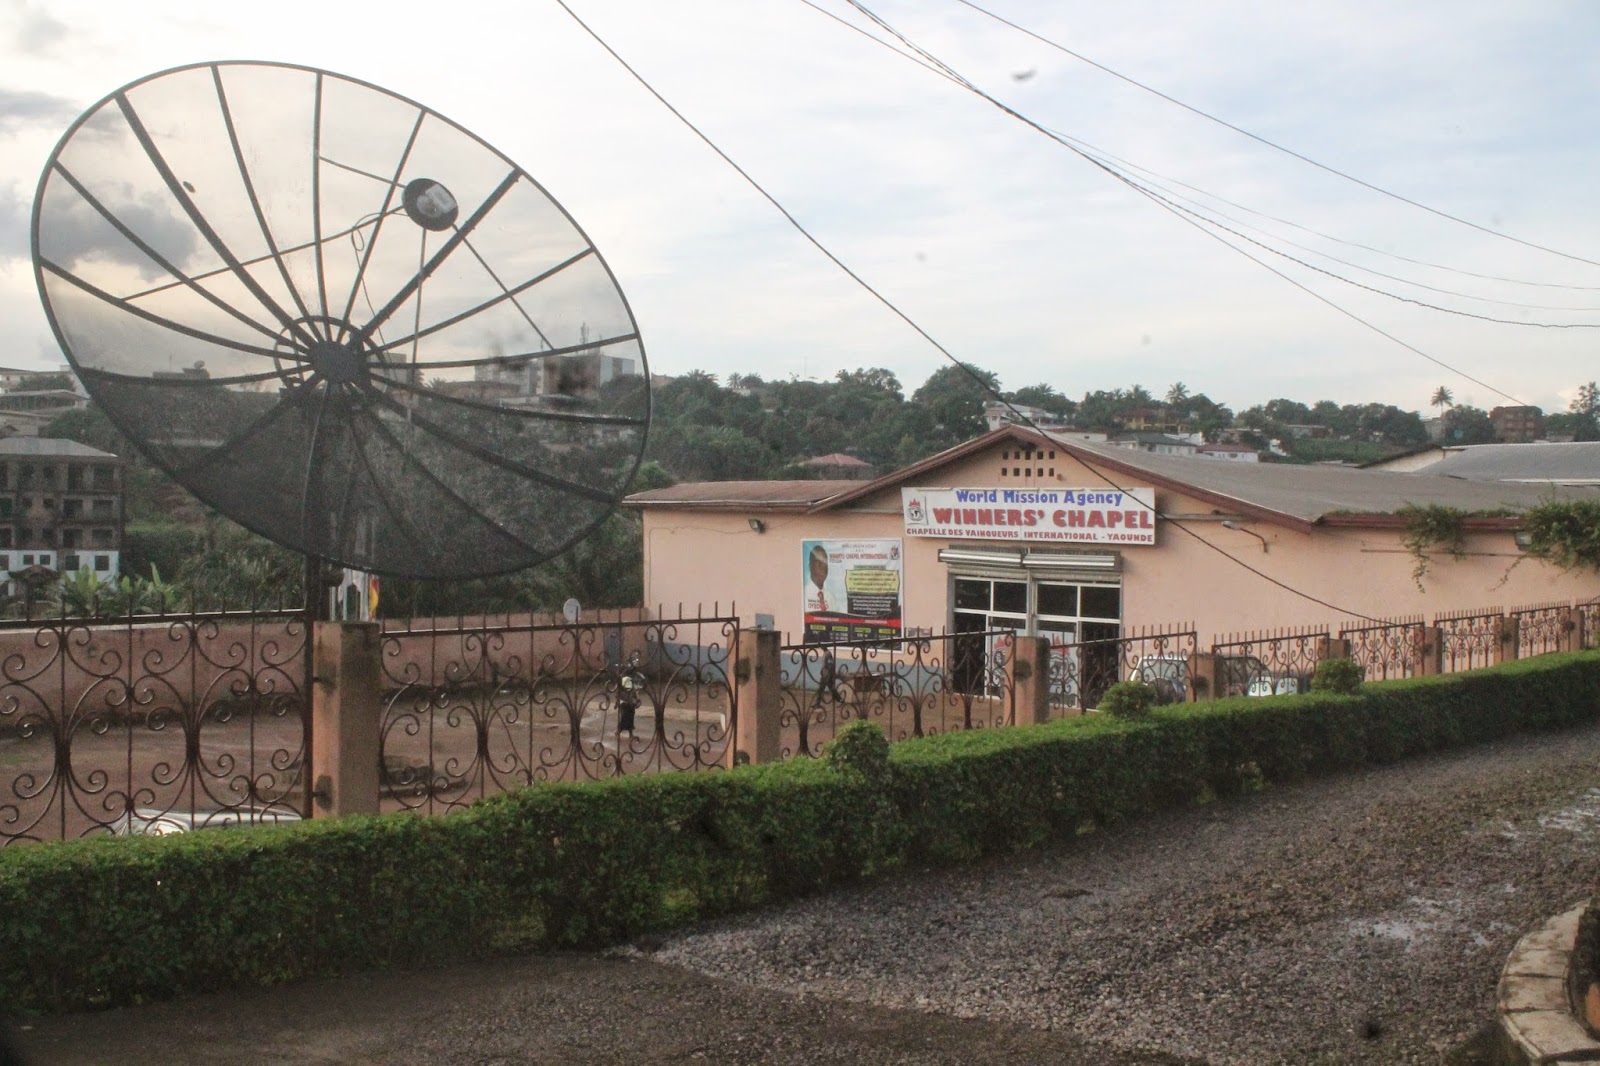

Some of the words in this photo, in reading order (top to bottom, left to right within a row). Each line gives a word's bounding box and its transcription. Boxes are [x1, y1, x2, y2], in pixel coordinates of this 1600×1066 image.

[956, 490, 997, 503] World
[1003, 490, 1058, 504] Mission
[1063, 491, 1123, 507] Agency
[932, 507, 1045, 526] WINNERS'
[1052, 510, 1154, 529] CHAPEL
[906, 528, 947, 536] CHAPELLE
[948, 529, 964, 537] DES
[965, 529, 1019, 538] VAINQUEURS
[1024, 531, 1098, 540] INTERNATIONAL
[1107, 533, 1153, 542] YAOUNDE
